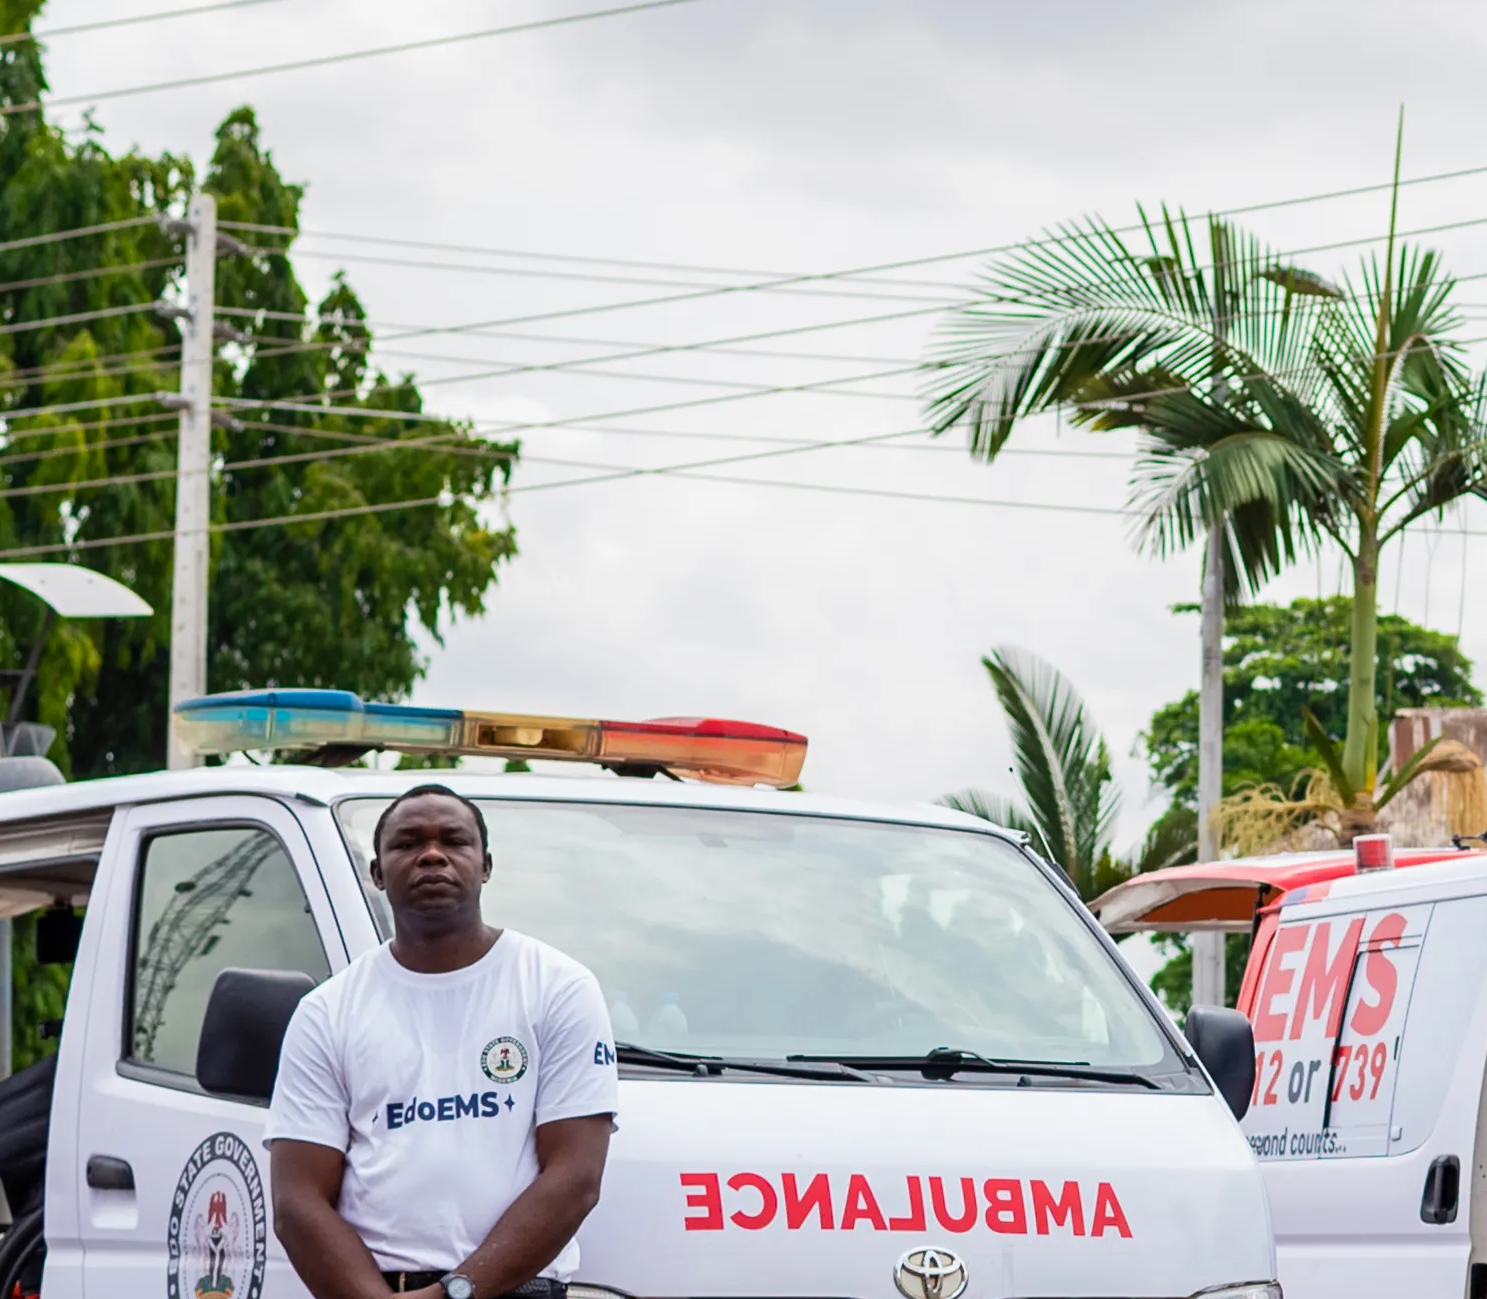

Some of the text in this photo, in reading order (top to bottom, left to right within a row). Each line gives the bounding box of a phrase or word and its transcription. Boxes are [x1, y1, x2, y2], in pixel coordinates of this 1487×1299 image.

[1254, 912, 1408, 1042] EMS
[387, 1091, 500, 1130] EdoEMS
[1251, 1041, 1387, 1106] 12 or 739
[168, 1135, 265, 1284] EDO STATE GOVERNMENT
